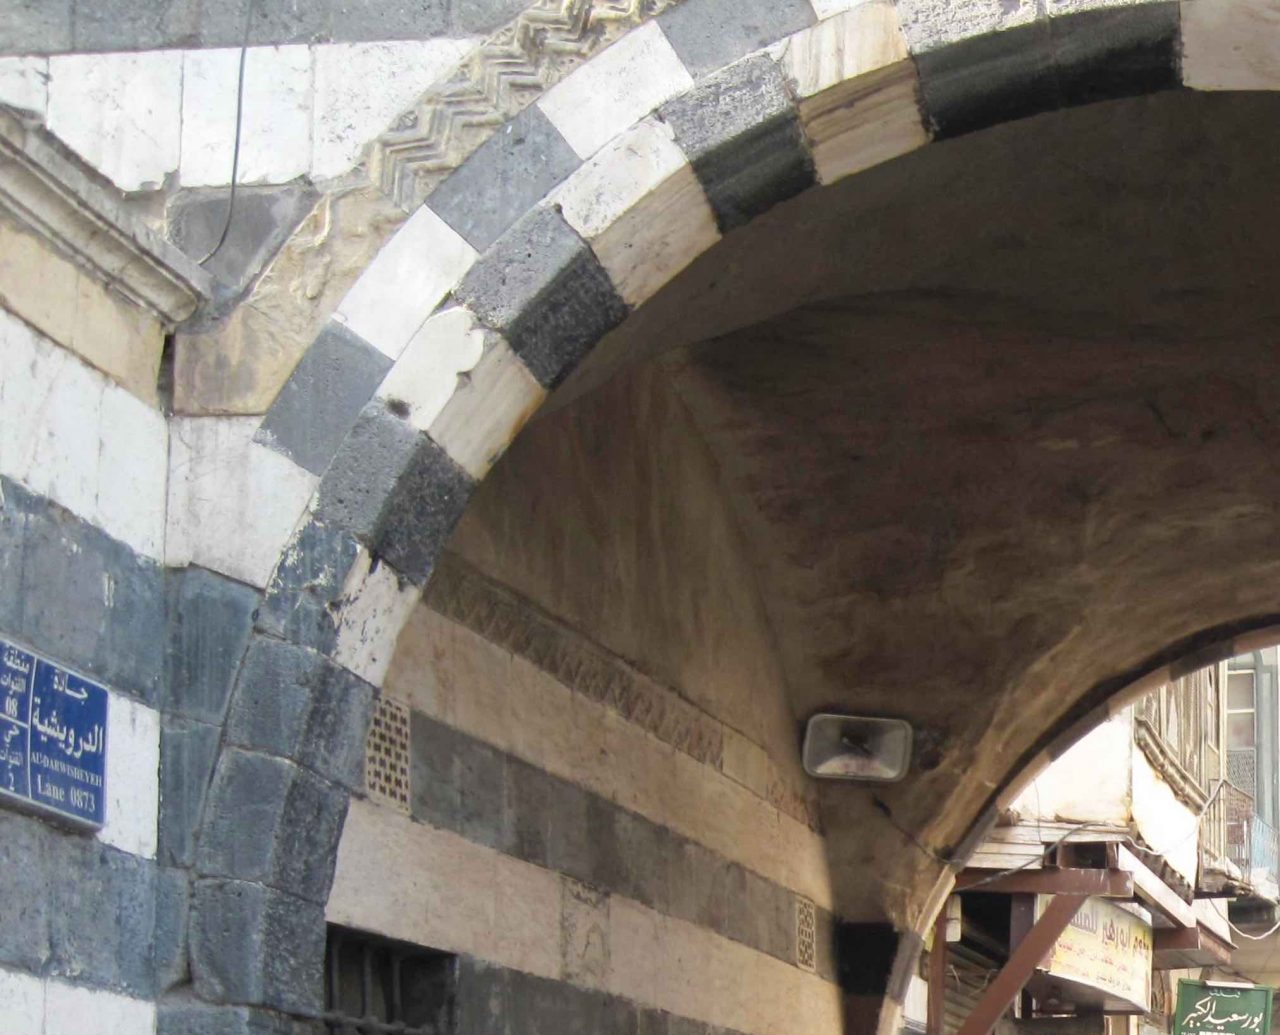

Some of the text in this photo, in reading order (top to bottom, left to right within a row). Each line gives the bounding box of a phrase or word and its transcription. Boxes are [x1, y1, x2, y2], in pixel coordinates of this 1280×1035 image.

[53, 669, 88, 705] جادة
[5, 698, 18, 718] 08
[33, 698, 104, 758] الدرويشية
[9, 773, 15, 791] 2
[37, 774, 96, 813] Lane 0873
[1182, 996, 1216, 1027] الكبير
